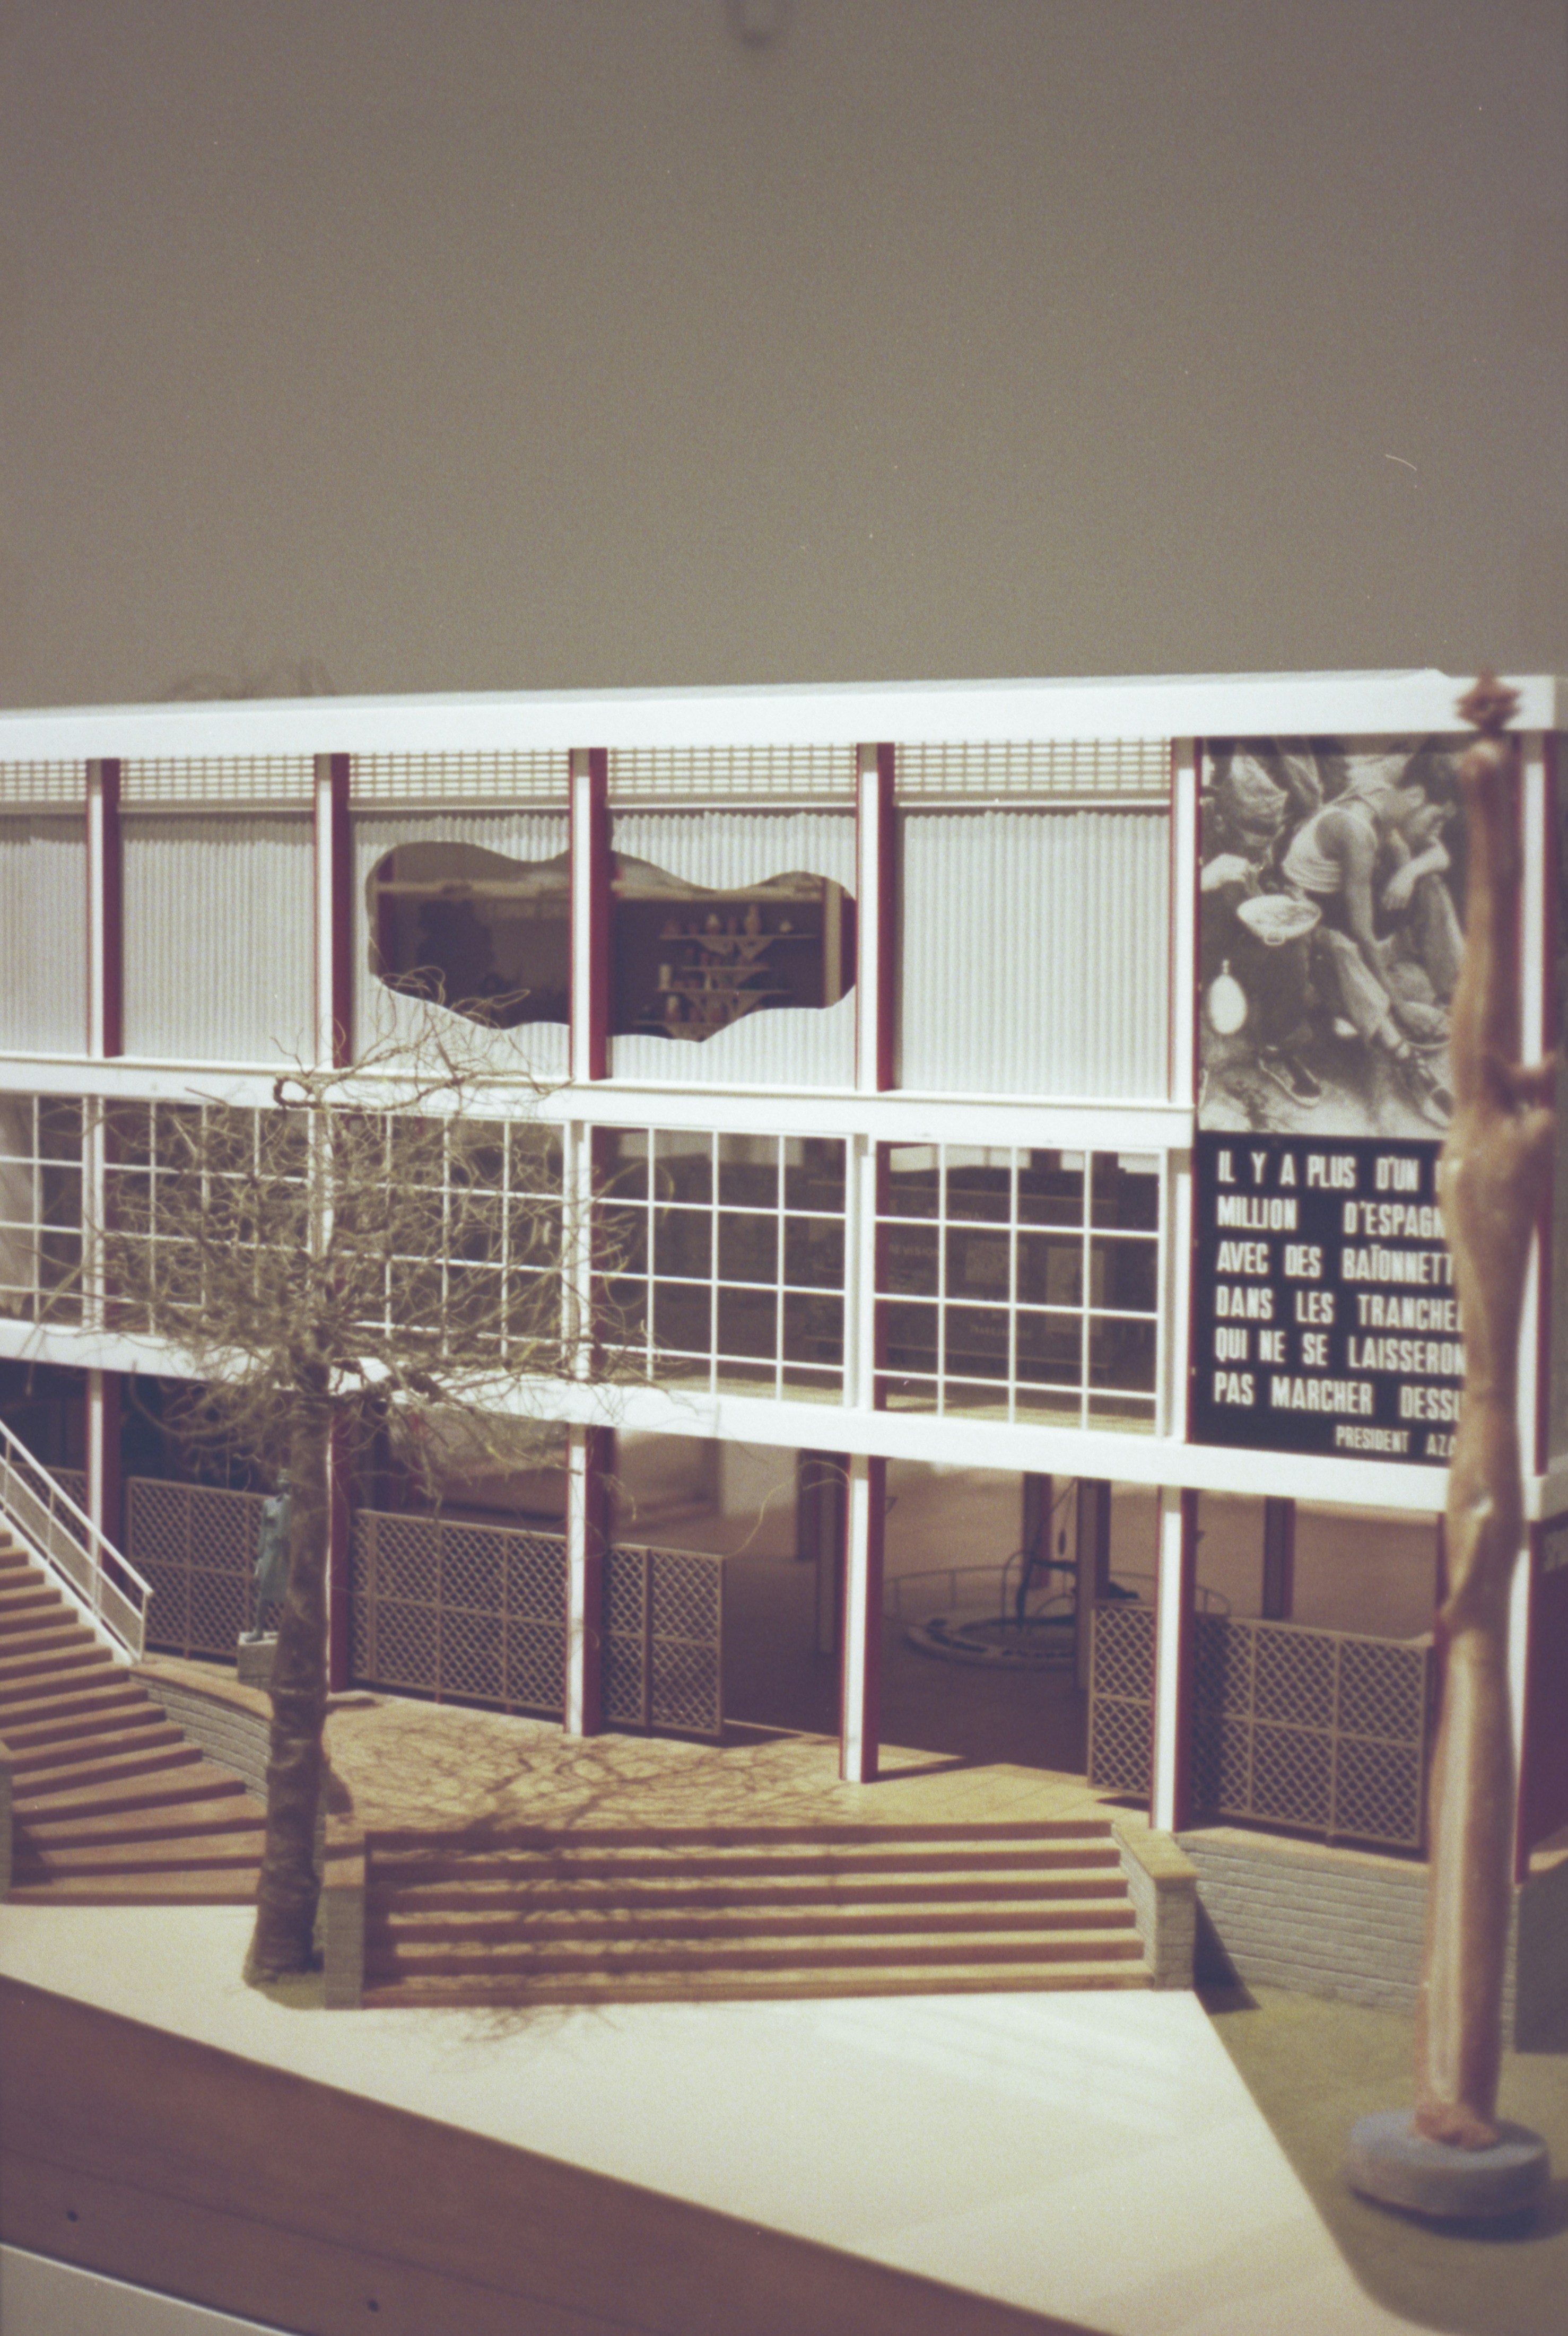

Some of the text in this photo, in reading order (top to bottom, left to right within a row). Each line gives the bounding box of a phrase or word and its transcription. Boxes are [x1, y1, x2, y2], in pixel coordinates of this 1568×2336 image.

[1218, 1150, 1235, 1183] IL
[1251, 1152, 1266, 1184] Y
[1279, 1153, 1296, 1186] A
[1307, 1155, 1356, 1189] PLUS
[1375, 1156, 1419, 1191] D'UN
[1217, 1195, 1297, 1231] MILLION
[1216, 1240, 1269, 1274] AVEC
[1284, 1244, 1322, 1278] DES
[1215, 1285, 1273, 1320] DANS
[1296, 1291, 1334, 1324] LES
[1215, 1326, 1248, 1363] QUI
[1259, 1330, 1285, 1363] NE
[1302, 1332, 1328, 1366] SE
[1214, 1371, 1254, 1406] PAS
[1271, 1375, 1373, 1415] MARCHER
[1336, 1425, 1409, 1453] PRESIDENT
